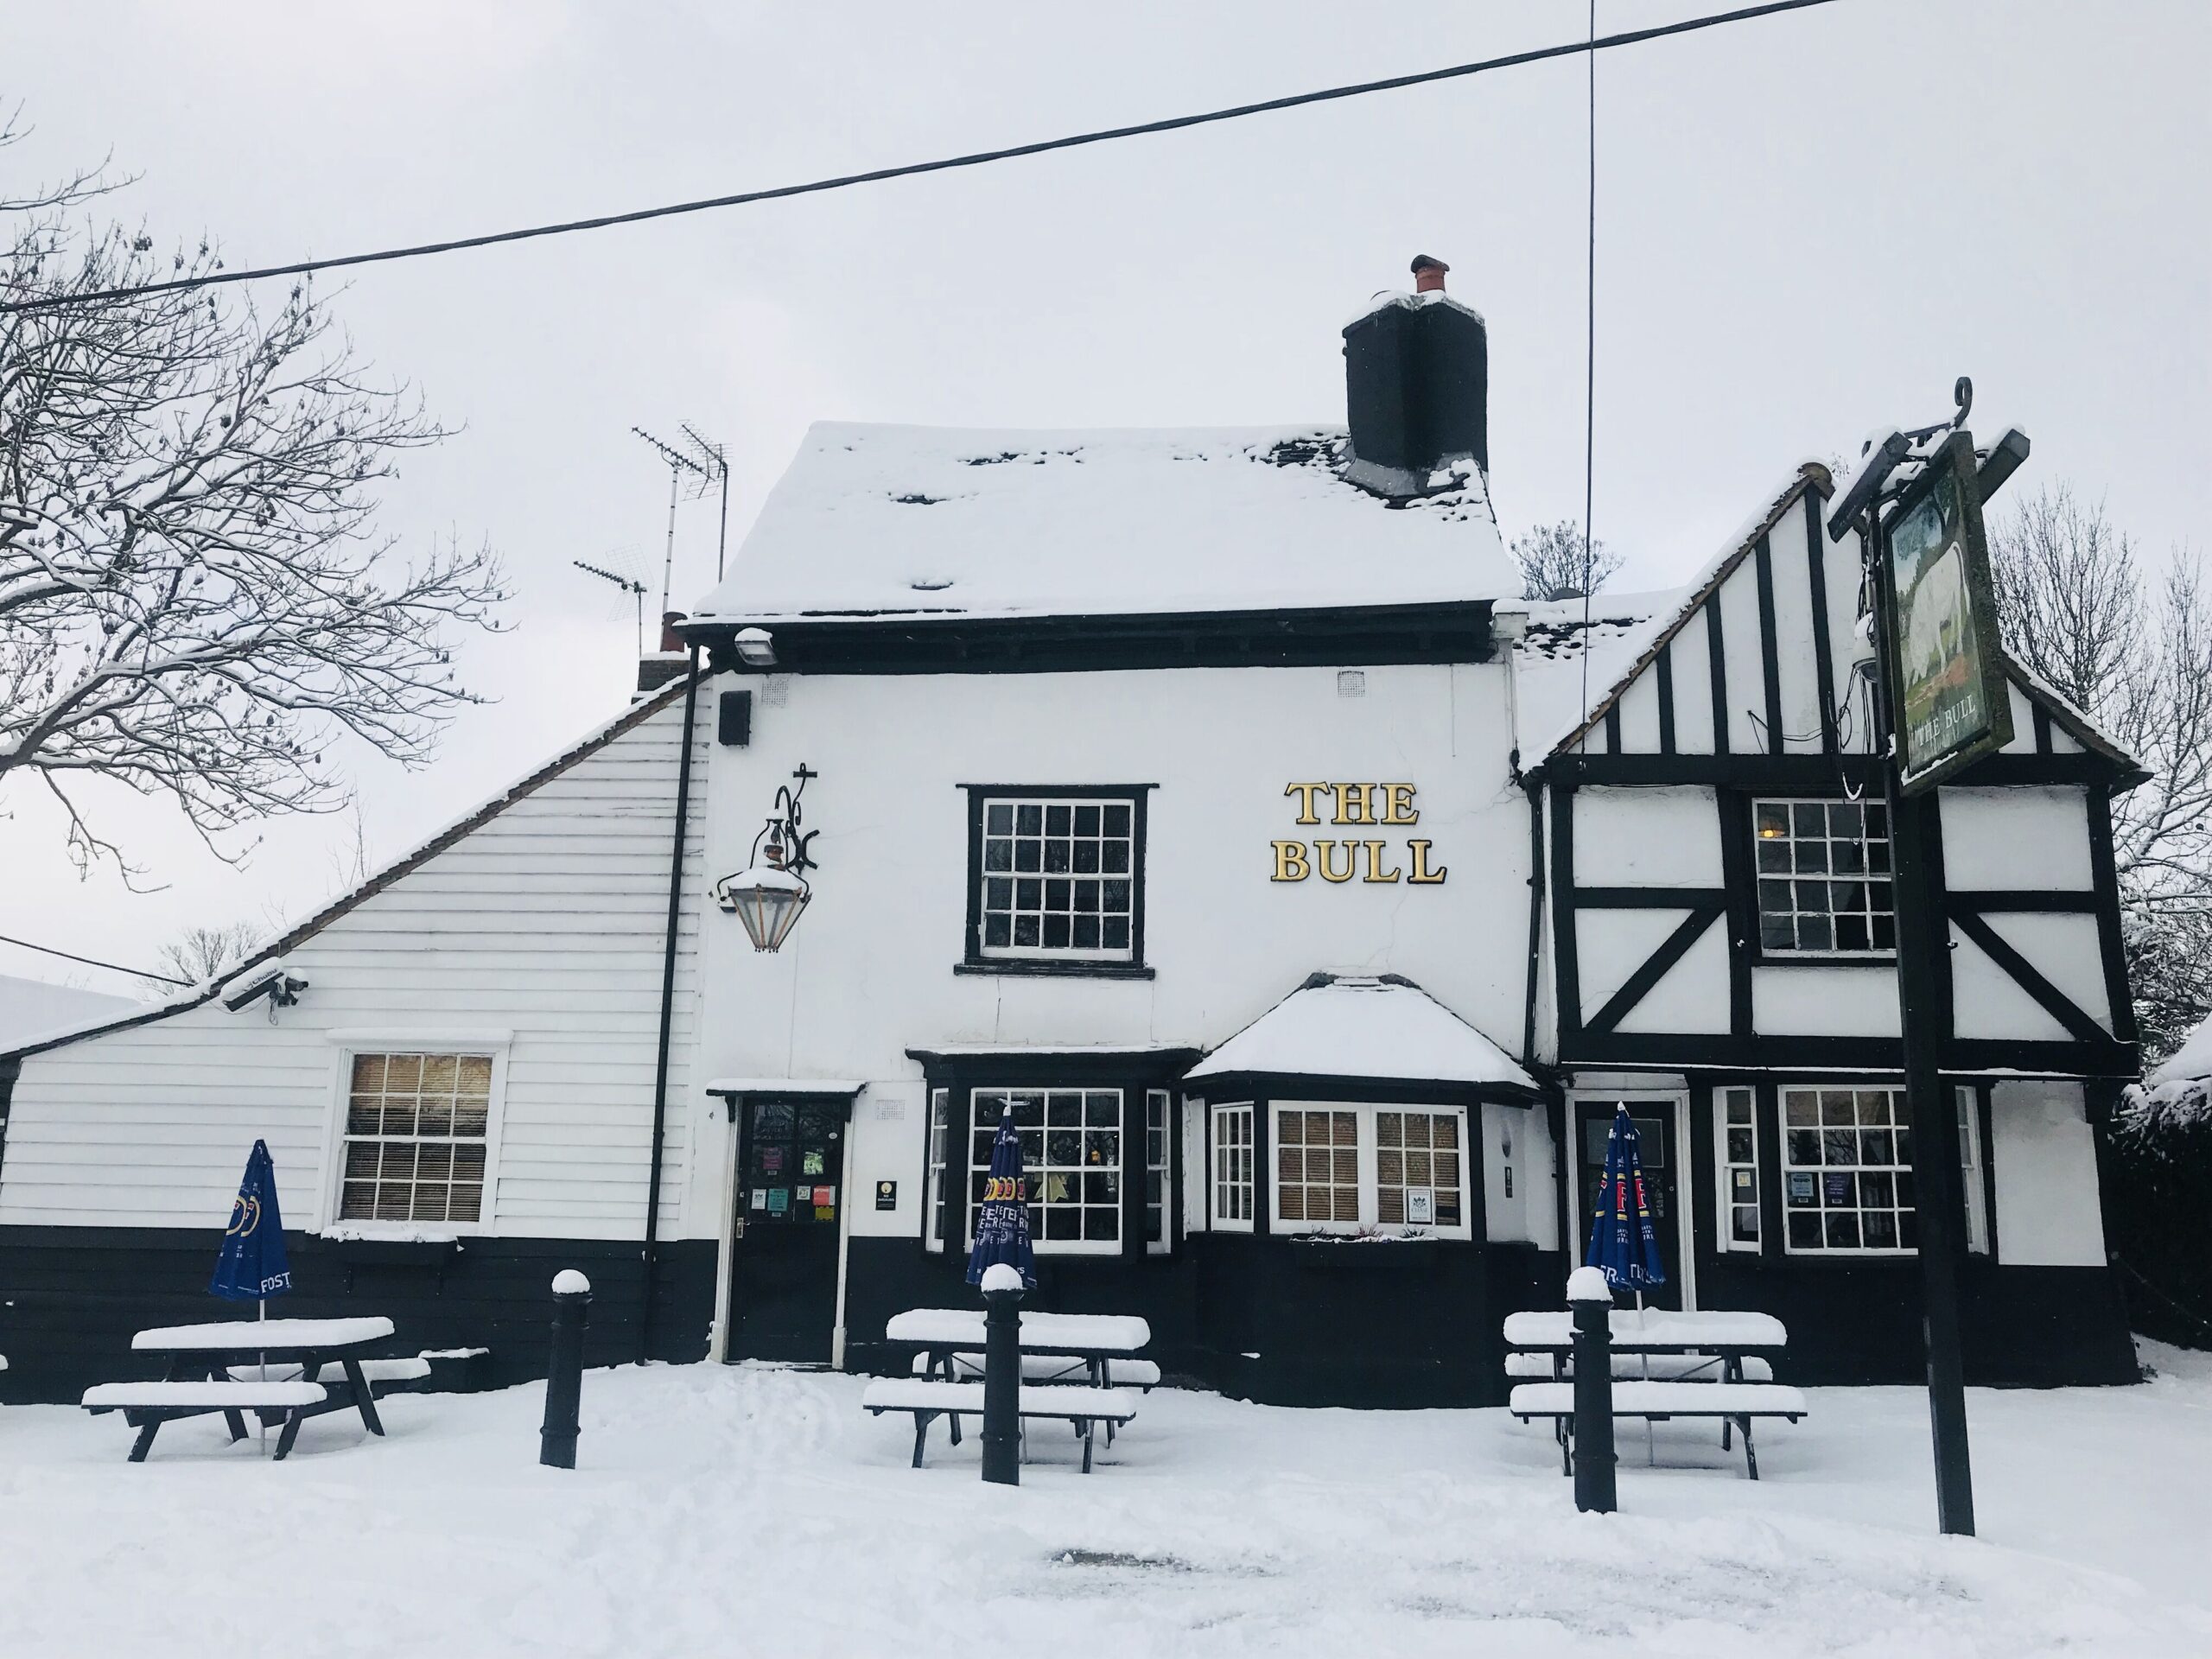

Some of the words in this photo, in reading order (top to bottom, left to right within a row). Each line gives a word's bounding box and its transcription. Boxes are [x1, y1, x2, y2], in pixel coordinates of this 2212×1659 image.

[1915, 717, 1941, 747] THE
[1944, 695, 1975, 728] BULL
[1284, 781, 1420, 825] THE
[1270, 839, 1447, 884] BULL
